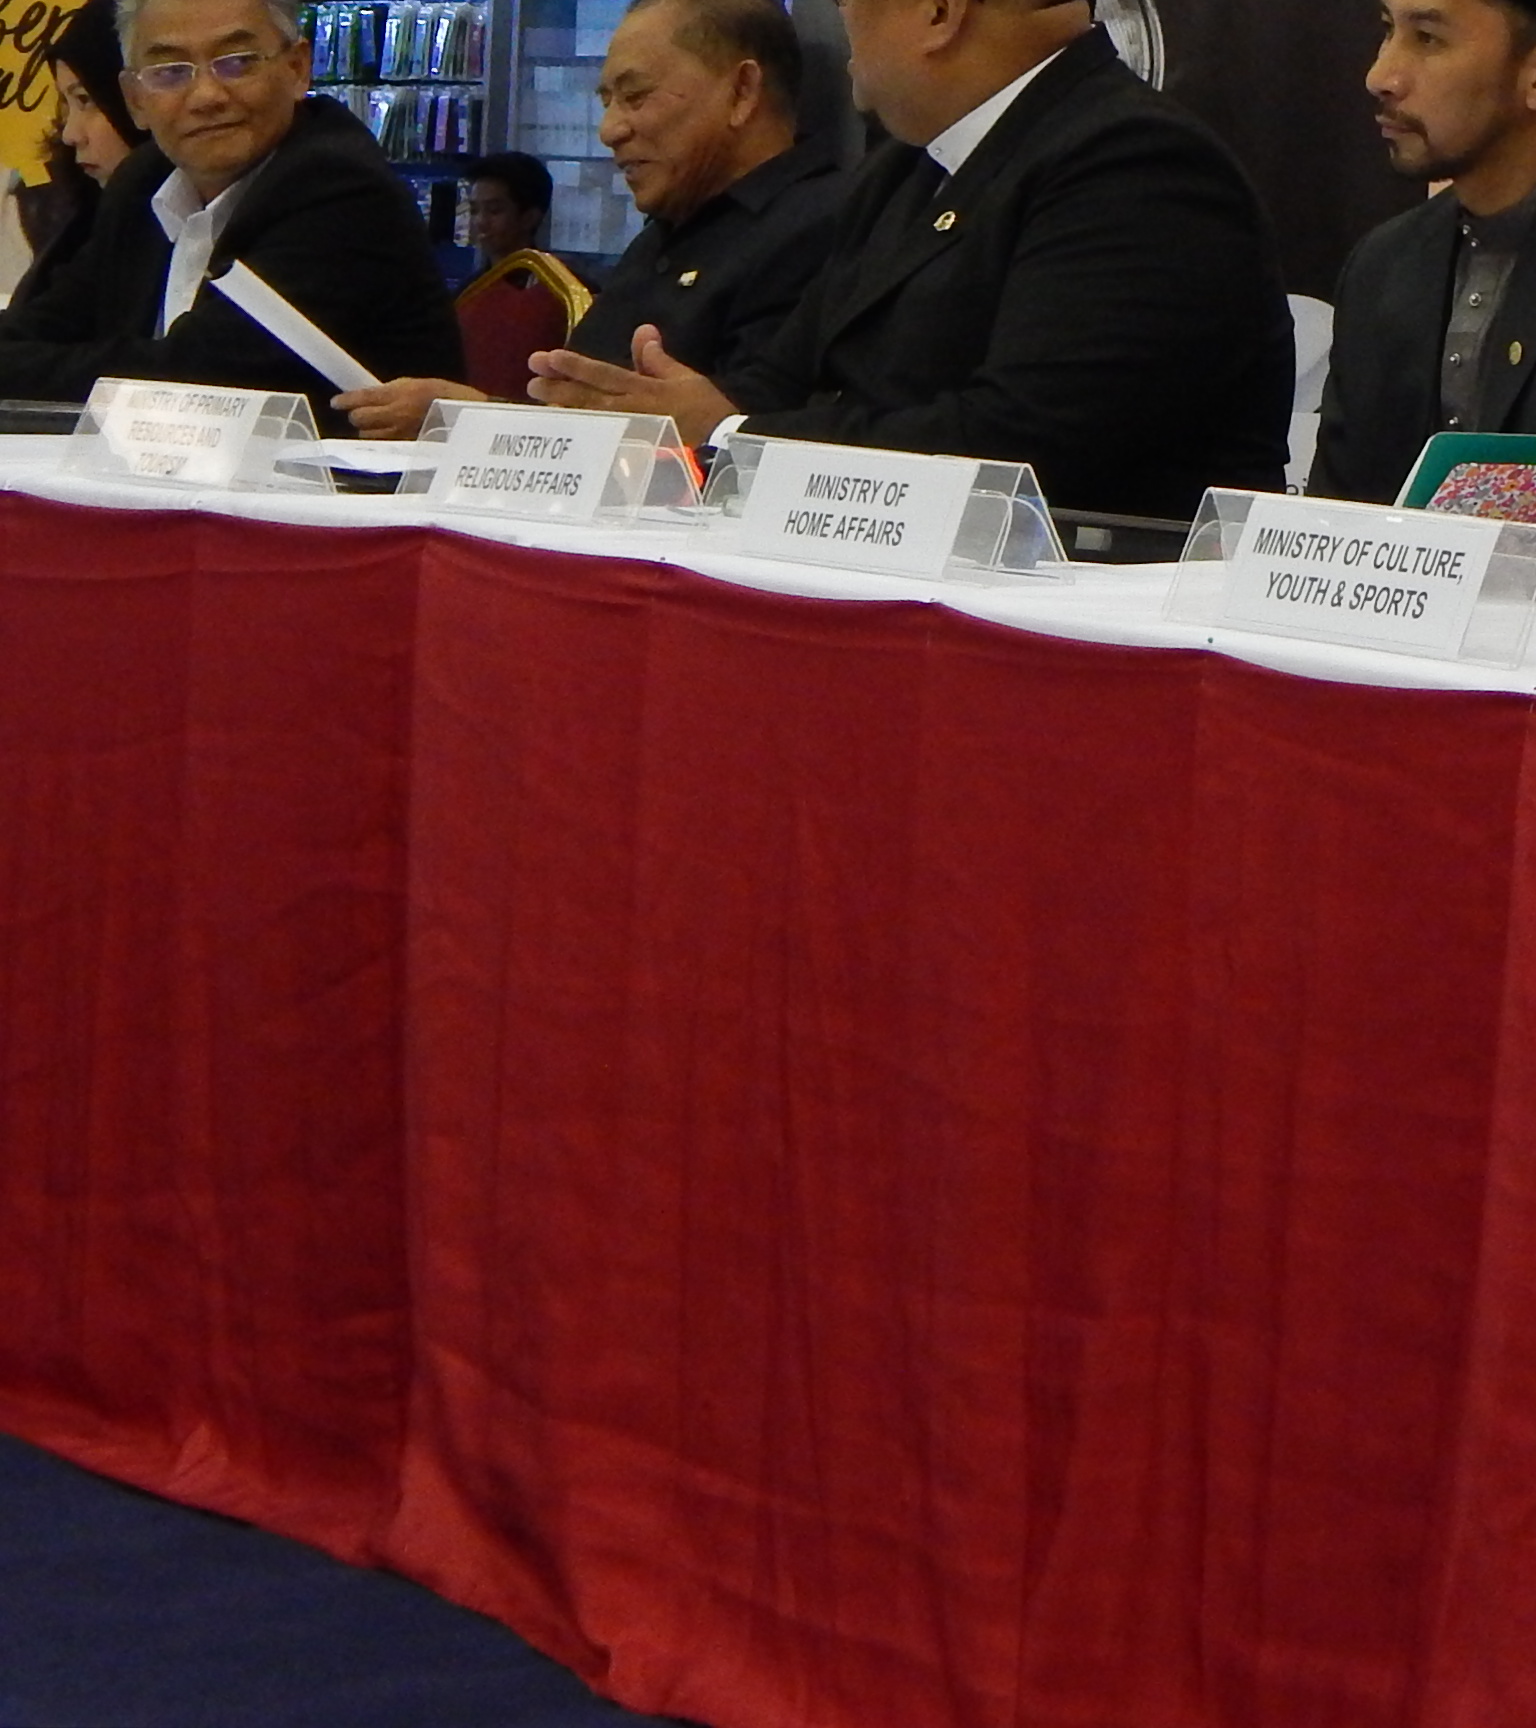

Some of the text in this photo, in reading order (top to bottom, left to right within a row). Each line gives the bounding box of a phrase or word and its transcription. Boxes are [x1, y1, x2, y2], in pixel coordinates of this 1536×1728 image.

[488, 433, 572, 460] MINISTRY OF
[454, 465, 582, 496] RELIGIOUS AFFAIRS
[803, 472, 909, 507] MINISTRY OF
[783, 509, 905, 547] HOME AFFAIRS
[1252, 527, 1466, 585] MINISTRY OF CULTURE,
[1265, 571, 1428, 619] YOUTH & SPORTS
